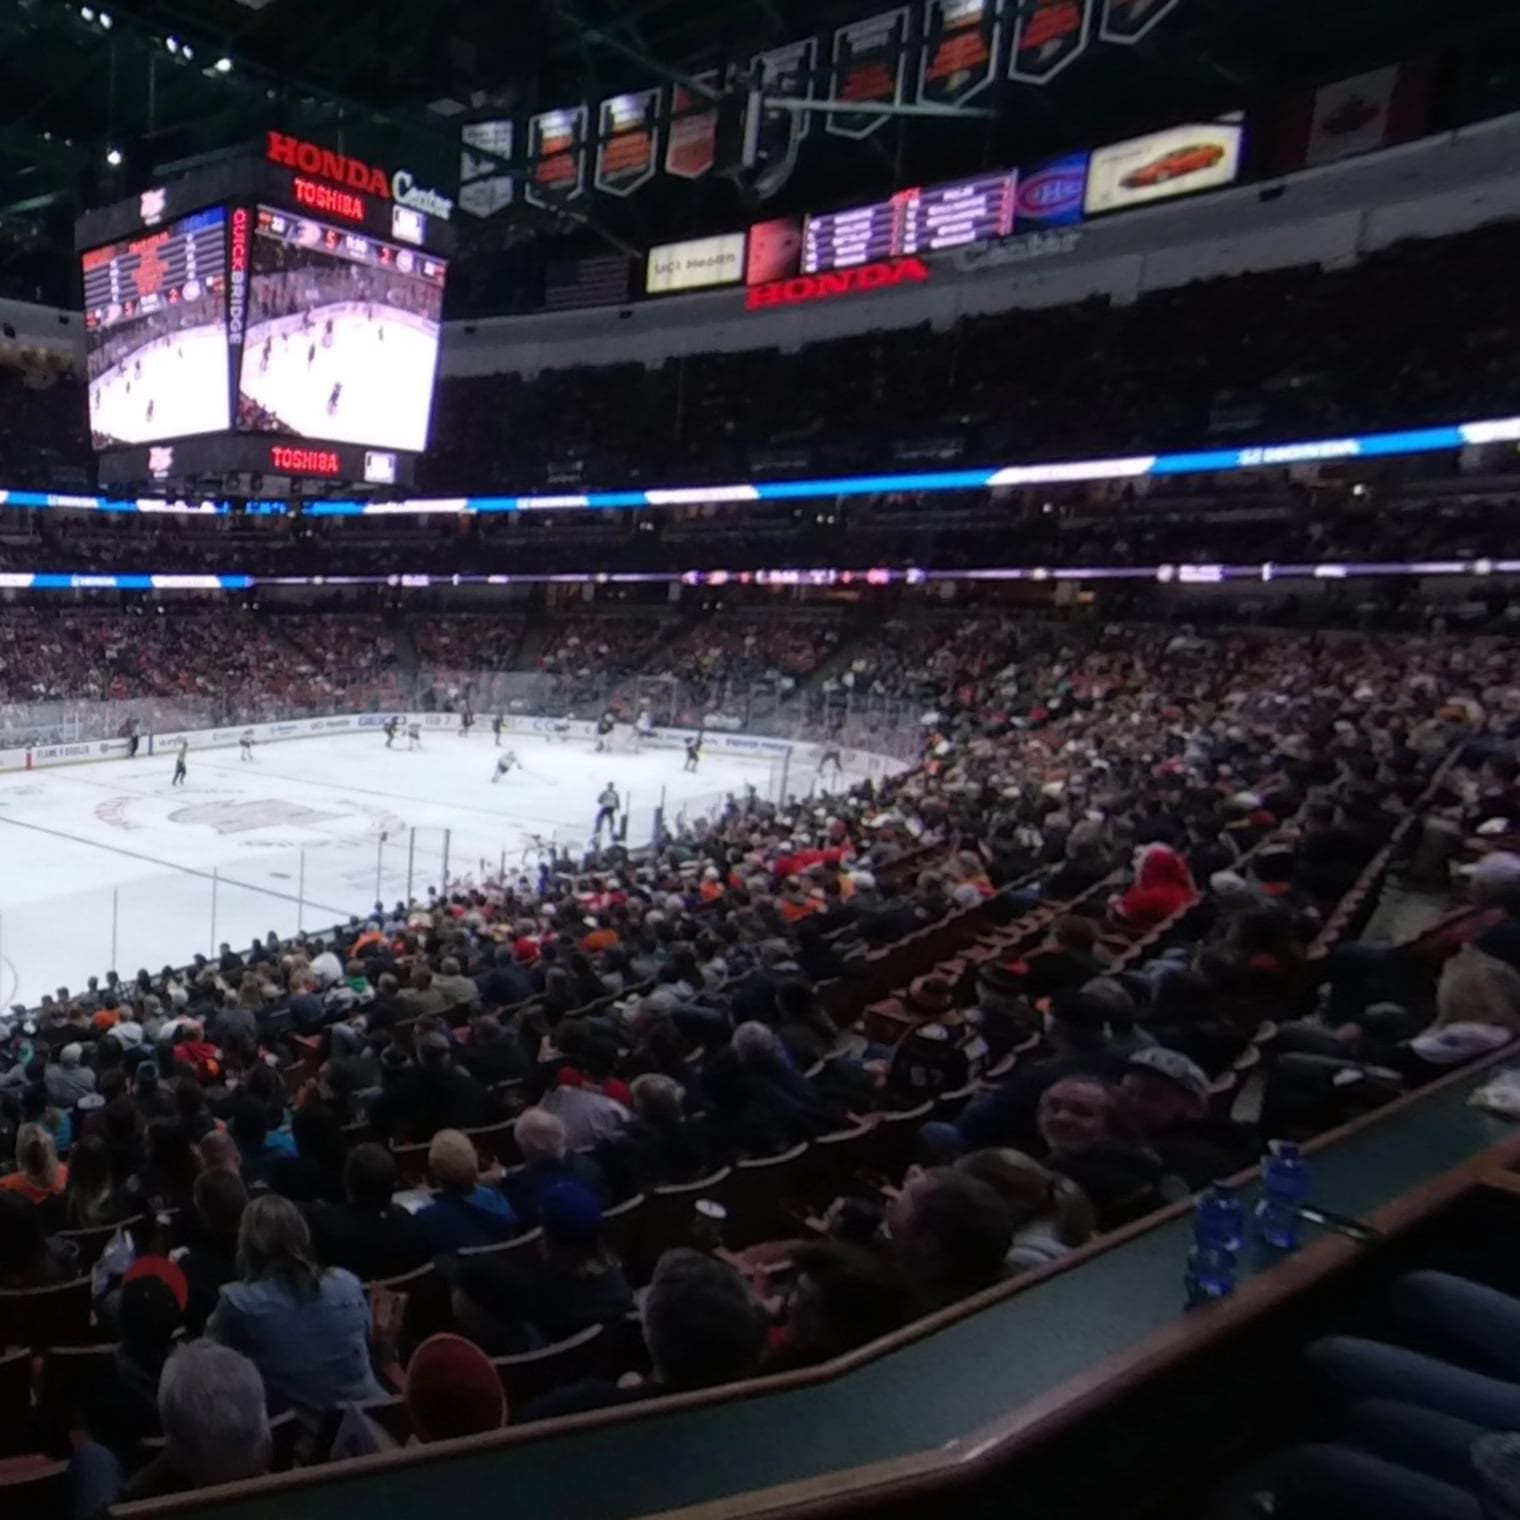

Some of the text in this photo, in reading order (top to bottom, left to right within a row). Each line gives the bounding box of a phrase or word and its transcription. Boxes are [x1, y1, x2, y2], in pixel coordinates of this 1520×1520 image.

[267, 130, 391, 199] HONDA
[392, 169, 453, 220] Center
[293, 176, 364, 221] TOSHIBA
[654, 253, 736, 276] UCI Health
[745, 256, 929, 311] HONDA
[271, 446, 339, 473] TOSHIBA
[357, 715, 407, 726] GEIO
